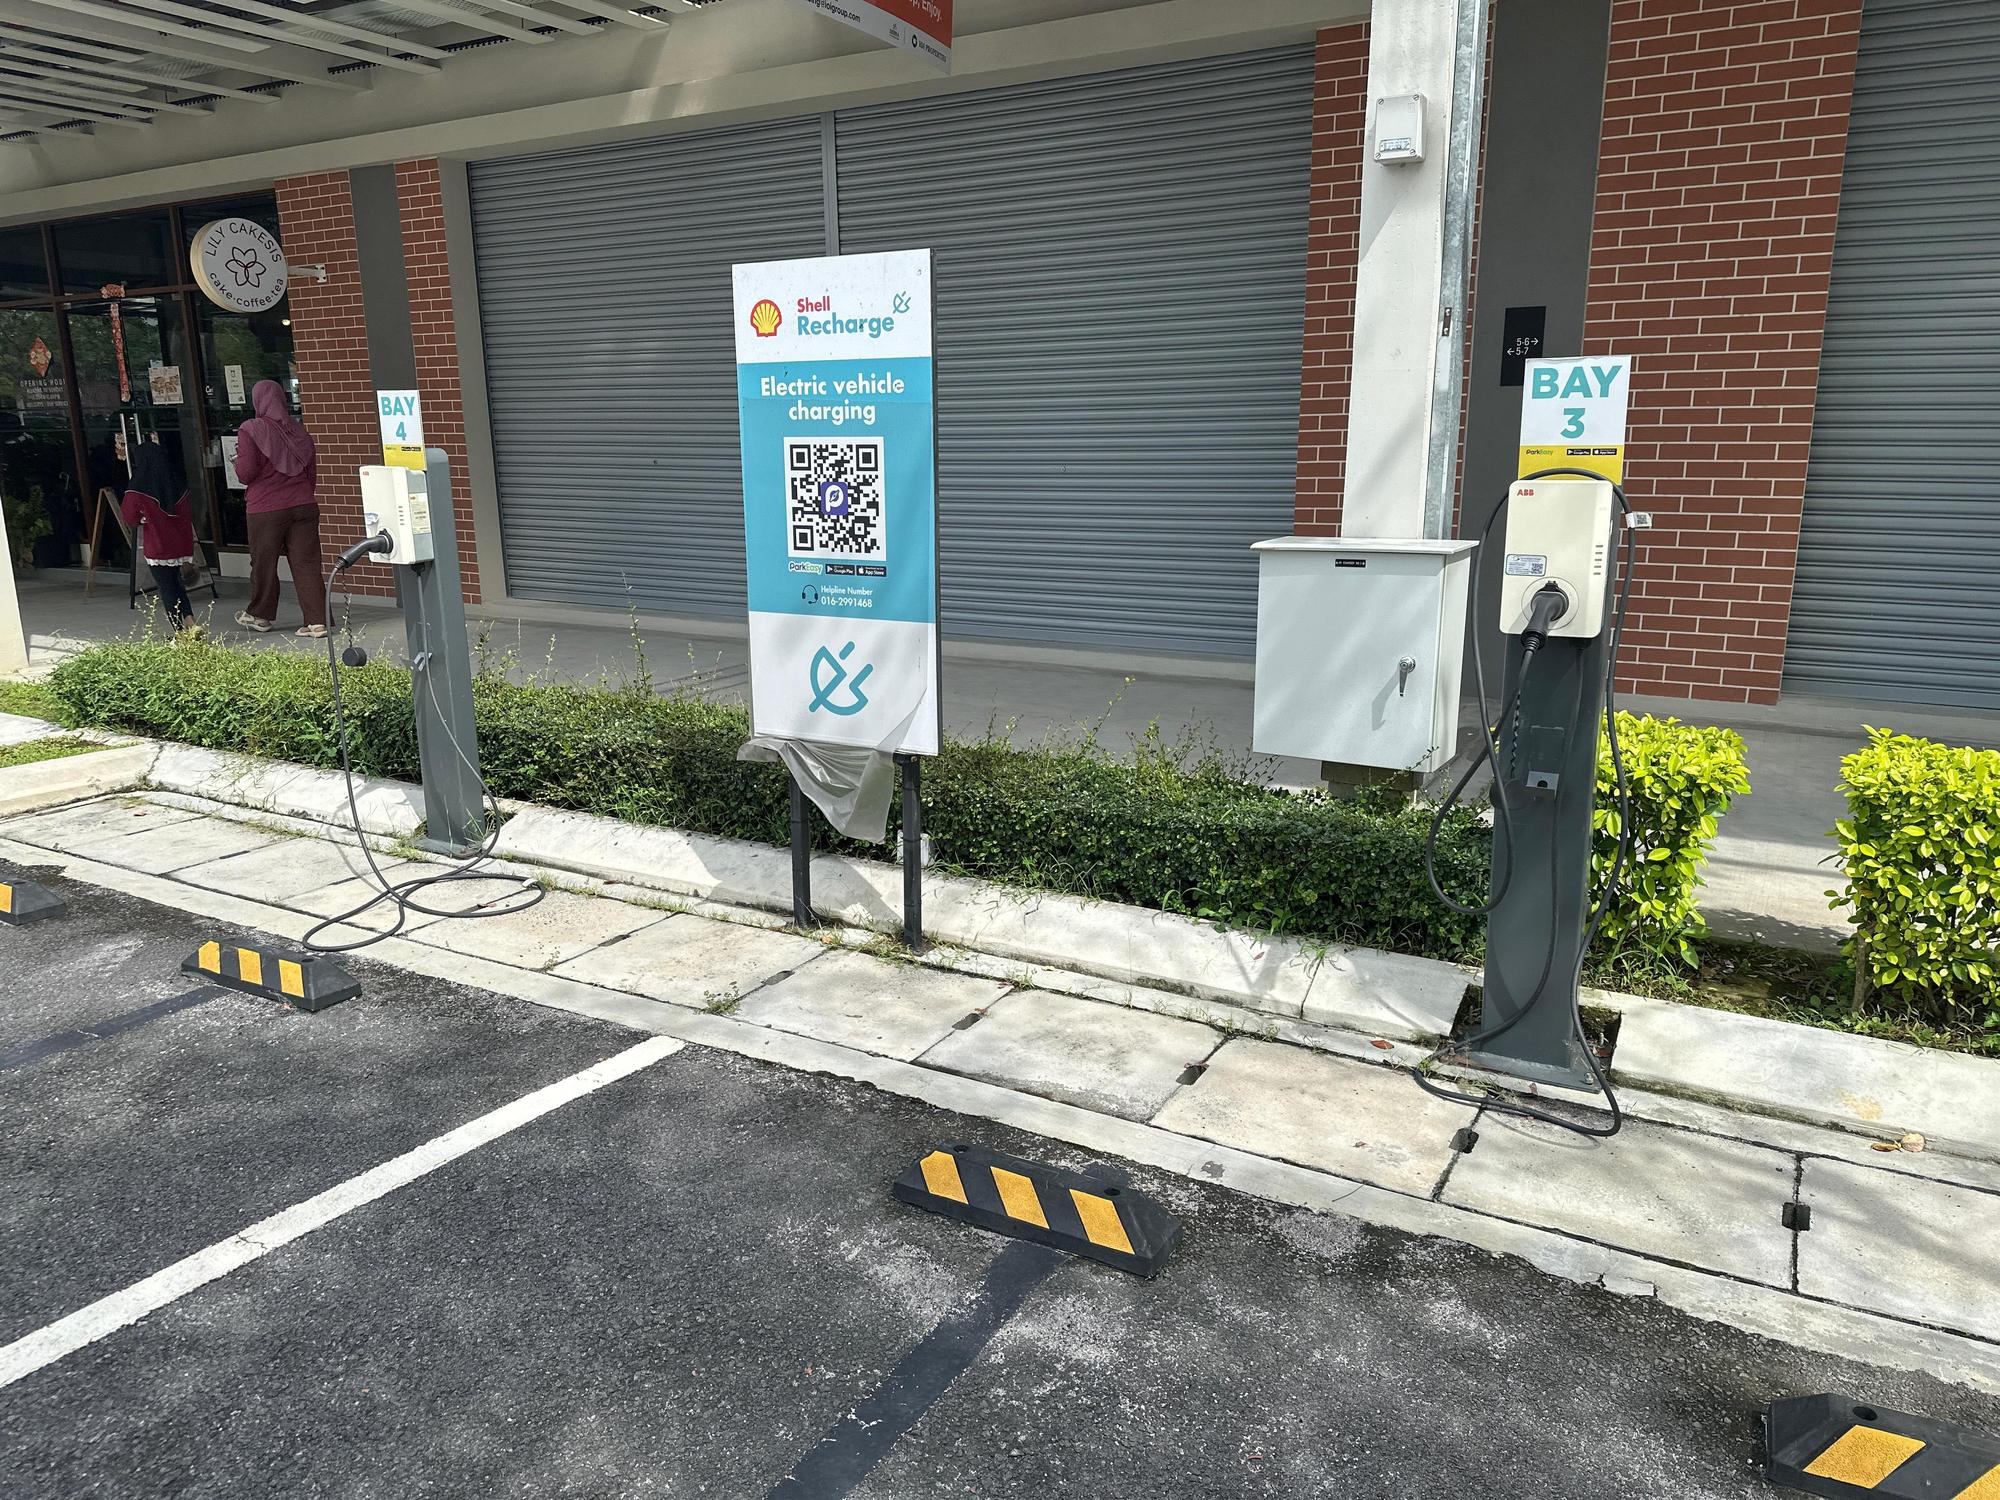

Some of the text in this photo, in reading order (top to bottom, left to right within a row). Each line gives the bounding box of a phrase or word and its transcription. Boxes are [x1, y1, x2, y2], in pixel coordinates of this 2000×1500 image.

[205, 222, 282, 263] LILY CAKESIS
[797, 295, 831, 313] Shell
[797, 312, 895, 338] Recharge
[1515, 346, 1529, 356] 5-7
[1516, 337, 1530, 347] 5-6
[760, 371, 905, 396] Electric vehicle
[1531, 365, 1623, 400] BAY
[380, 396, 415, 416] BAY
[788, 399, 876, 425] charging
[395, 421, 407, 441] 4
[1560, 407, 1586, 439] 3
[821, 585, 873, 596] Helpline Number
[821, 596, 873, 608] 016-2991468
